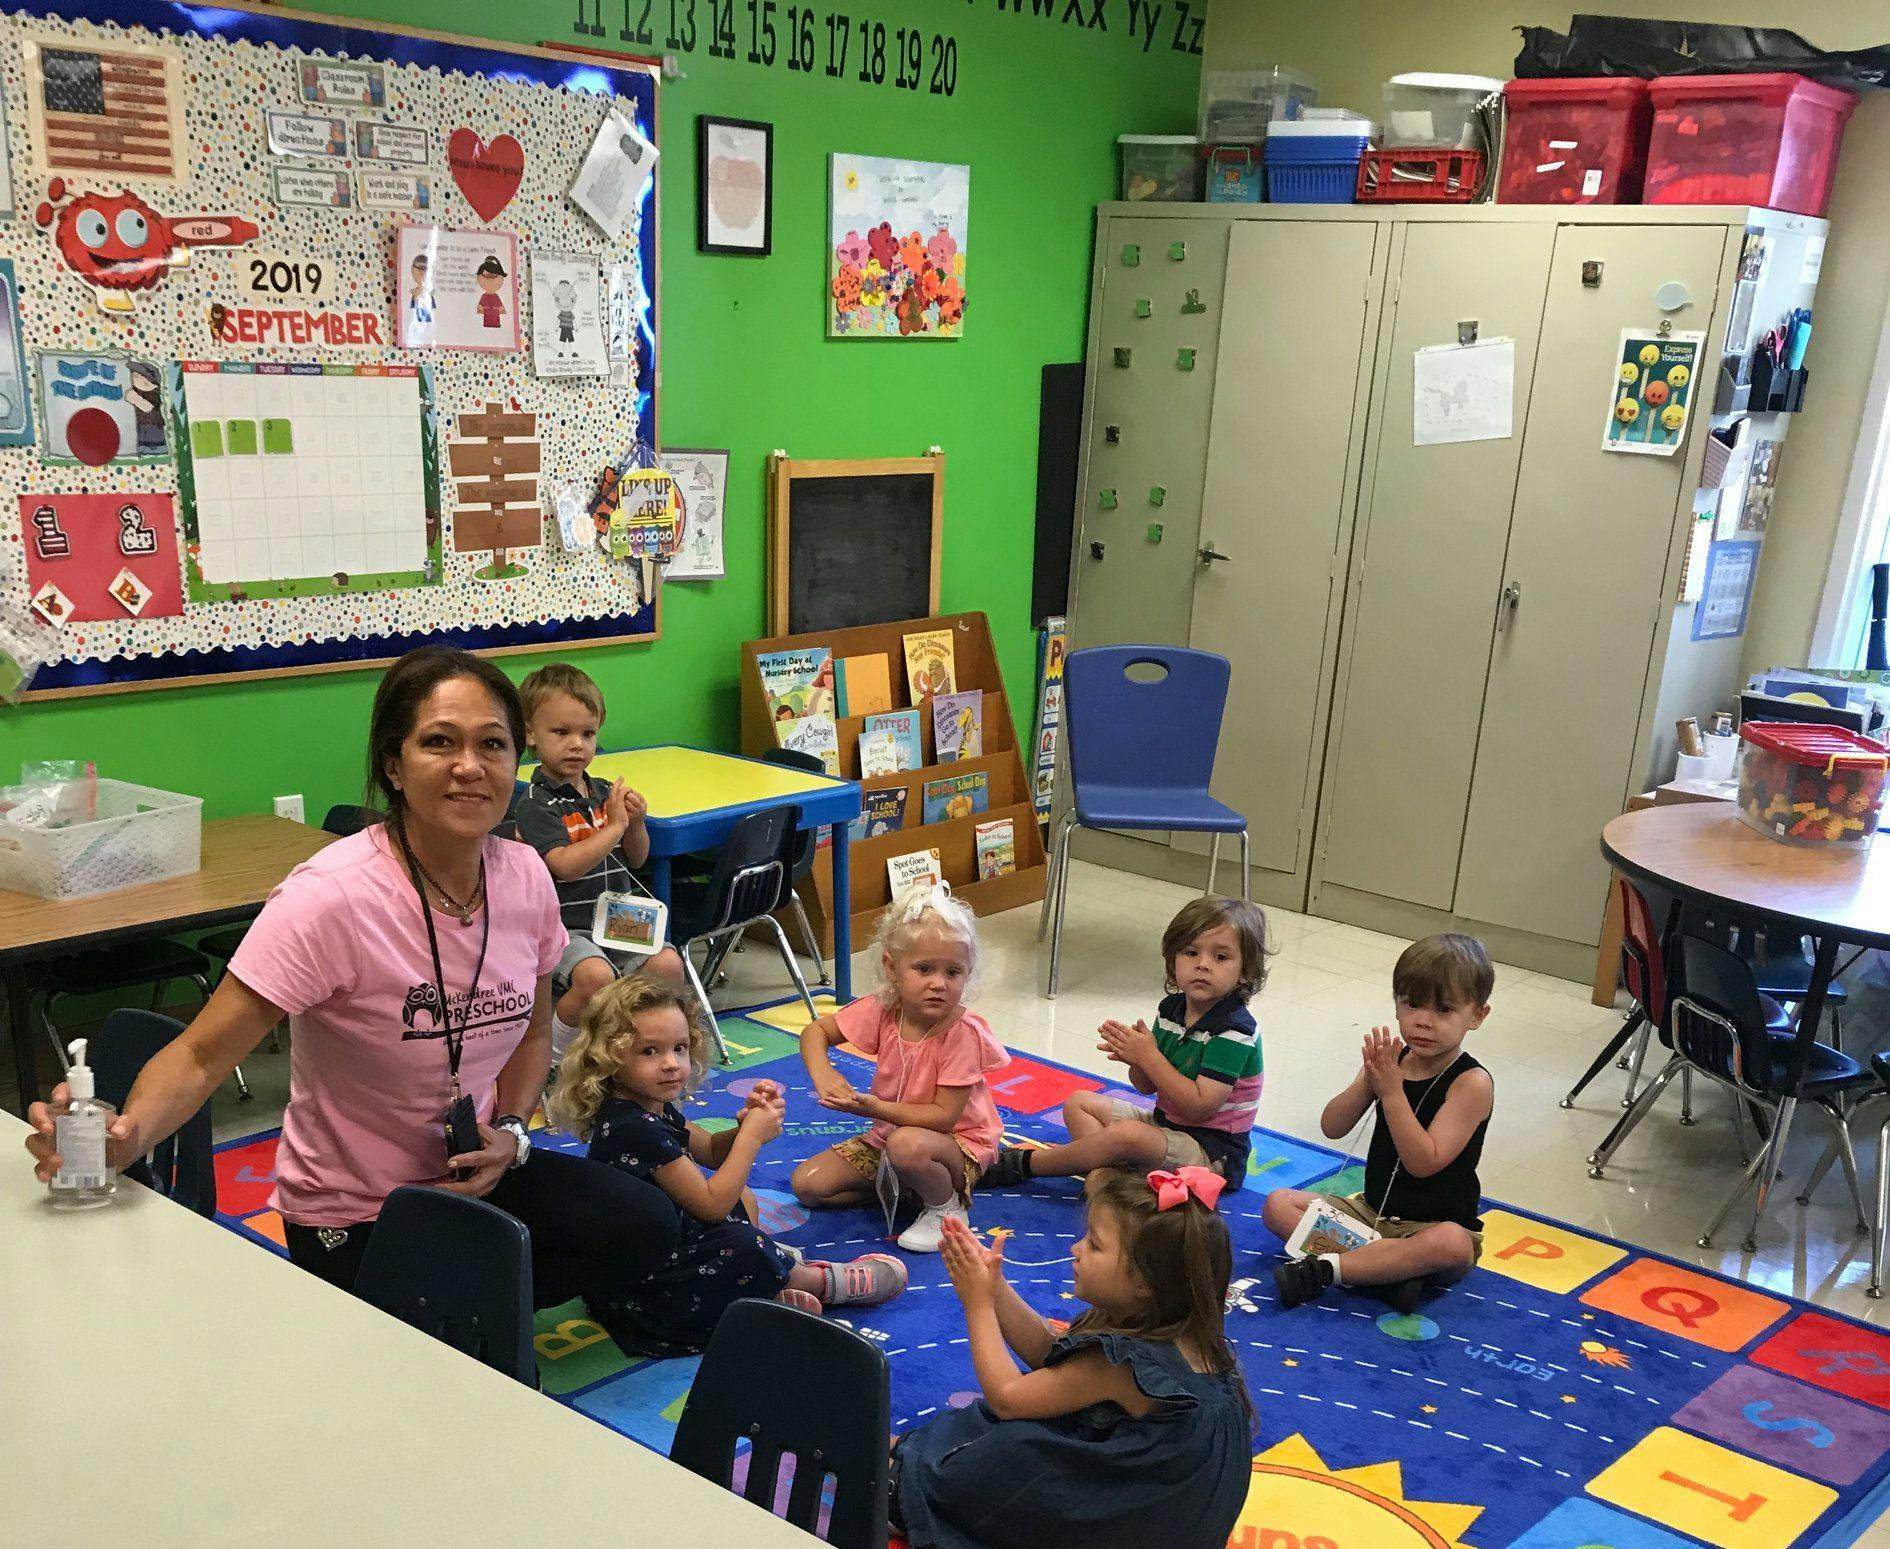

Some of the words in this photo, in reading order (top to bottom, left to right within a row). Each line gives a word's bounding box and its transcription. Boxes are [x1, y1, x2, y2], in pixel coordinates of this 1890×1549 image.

[1172, 1, 1205, 56] Zz
[620, 0, 652, 44] 12
[666, 0, 696, 52] 13
[709, 0, 736, 59] 14
[747, 1, 776, 66] 15
[787, 5, 815, 73] 16
[825, 12, 850, 78] 17
[859, 19, 886, 85] 18
[896, 27, 921, 91] 19
[930, 34, 957, 97] 20
[285, 120, 313, 132] Follow
[278, 132, 324, 146] directions
[192, 225, 213, 236] red
[250, 260, 322, 294] 2019
[222, 309, 384, 345] SEPTEMBER
[1664, 344, 1693, 354] Express
[654, 478, 672, 495] UP
[32, 506, 70, 556] 1
[120, 504, 157, 554] 2
[759, 659, 770, 669] My
[772, 658, 787, 667] First
[788, 656, 803, 667] Day
[804, 655, 813, 663] at
[765, 667, 792, 678] Nursery
[793, 664, 818, 675] School
[947, 701, 955, 709] Do
[805, 722, 834, 742] Cowgirl
[957, 777, 974, 791] School
[974, 776, 986, 788] Dog
[871, 808, 900, 821] SCHOOL!
[875, 803, 879, 811] I
[880, 800, 899, 811] LOVE
[893, 860, 909, 871] Spot
[909, 856, 926, 866] Goes
[901, 870, 909, 878] to
[909, 863, 930, 876] School
[446, 991, 532, 1023] PRESCHOOL
[1494, 1236, 1564, 1262] P
[1640, 1286, 1720, 1329] Q
[534, 1319, 610, 1360] B
[1464, 1345, 1555, 1382] Earth
[1799, 1349, 1890, 1376] R
[1743, 1400, 1836, 1449] S
